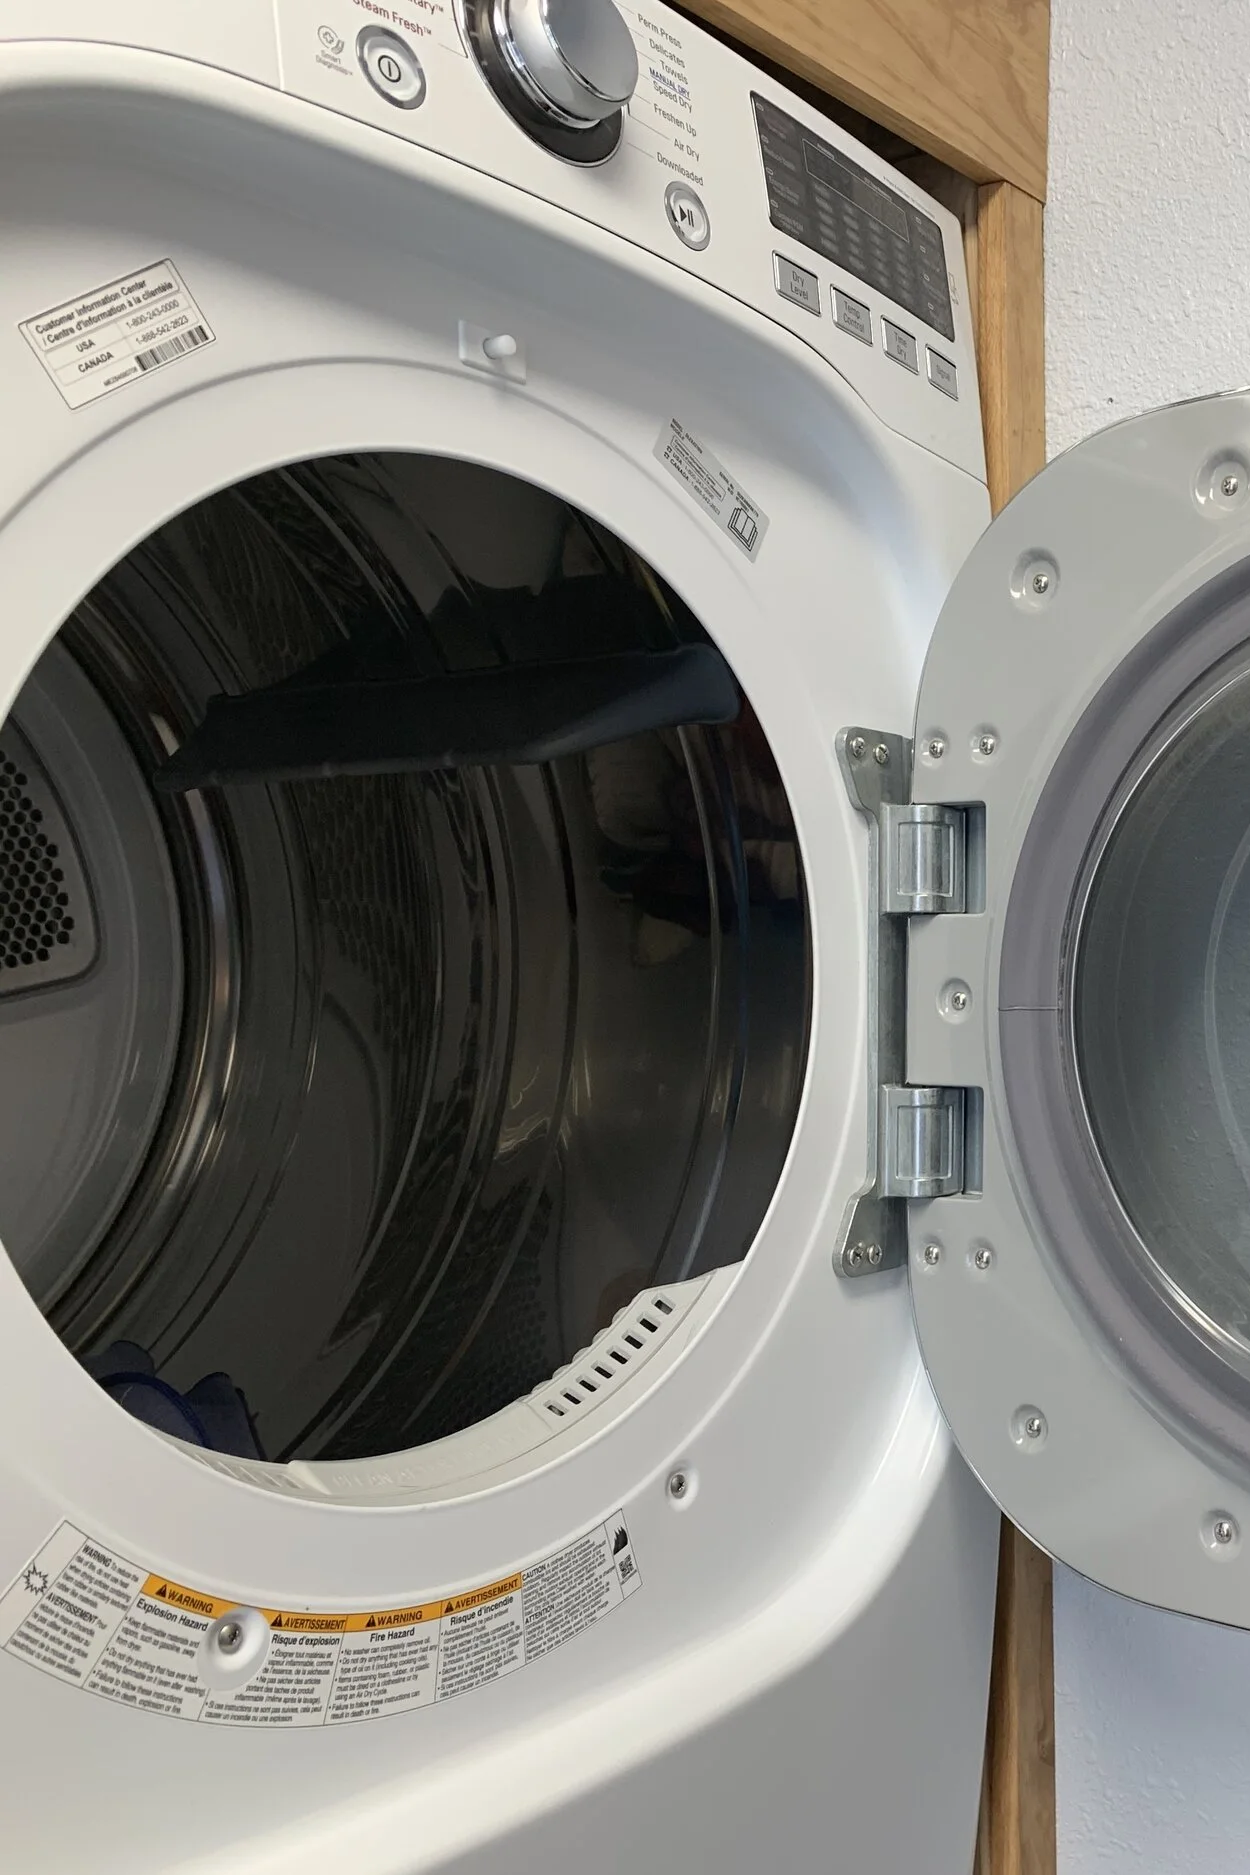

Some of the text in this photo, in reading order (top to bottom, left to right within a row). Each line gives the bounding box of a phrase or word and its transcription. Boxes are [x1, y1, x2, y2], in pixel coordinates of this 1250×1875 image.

[637, 13, 682, 49] Perm Press
[649, 38, 685, 68] Delicates
[649, 66, 690, 98] MANUAL DRY
[660, 59, 688, 85] Towels
[653, 80, 692, 114] Speed Dry
[654, 103, 697, 137] Freshen Up
[674, 138, 700, 162] Air Dry
[657, 151, 704, 186] Downloaded
[790, 280, 809, 301] Level
[792, 271, 805, 287] Dry
[35, 280, 146, 334] Customer Information Center
[47, 322, 76, 345] Centre
[77, 303, 128, 332] d'information
[134, 293, 143, 305] la
[142, 280, 173, 300] clientèle
[844, 299, 860, 319] Temp
[843, 312, 865, 333] Control
[76, 338, 96, 353] USA
[78, 350, 114, 373] CANADA
[82, 1544, 111, 1567] WARNING
[523, 1564, 546, 1581] CAUTION
[168, 1589, 214, 1614] WARNING
[455, 1579, 518, 1610] AVERTISSEMENT
[46, 1592, 98, 1624] AVERTISSEMENT
[136, 1598, 209, 1631] Explosion Hazard
[377, 1611, 422, 1626] WARNING
[451, 1596, 514, 1626] Risque d'incendie
[525, 1604, 555, 1624] ATTENTION
[283, 1617, 346, 1630] AVERTISSEMENT
[370, 1627, 415, 1642] Fire Hazard
[272, 1634, 340, 1646] Risque d'explosion
[364, 1689, 372, 1697] Dry
[332, 1702, 349, 1710] Failure
